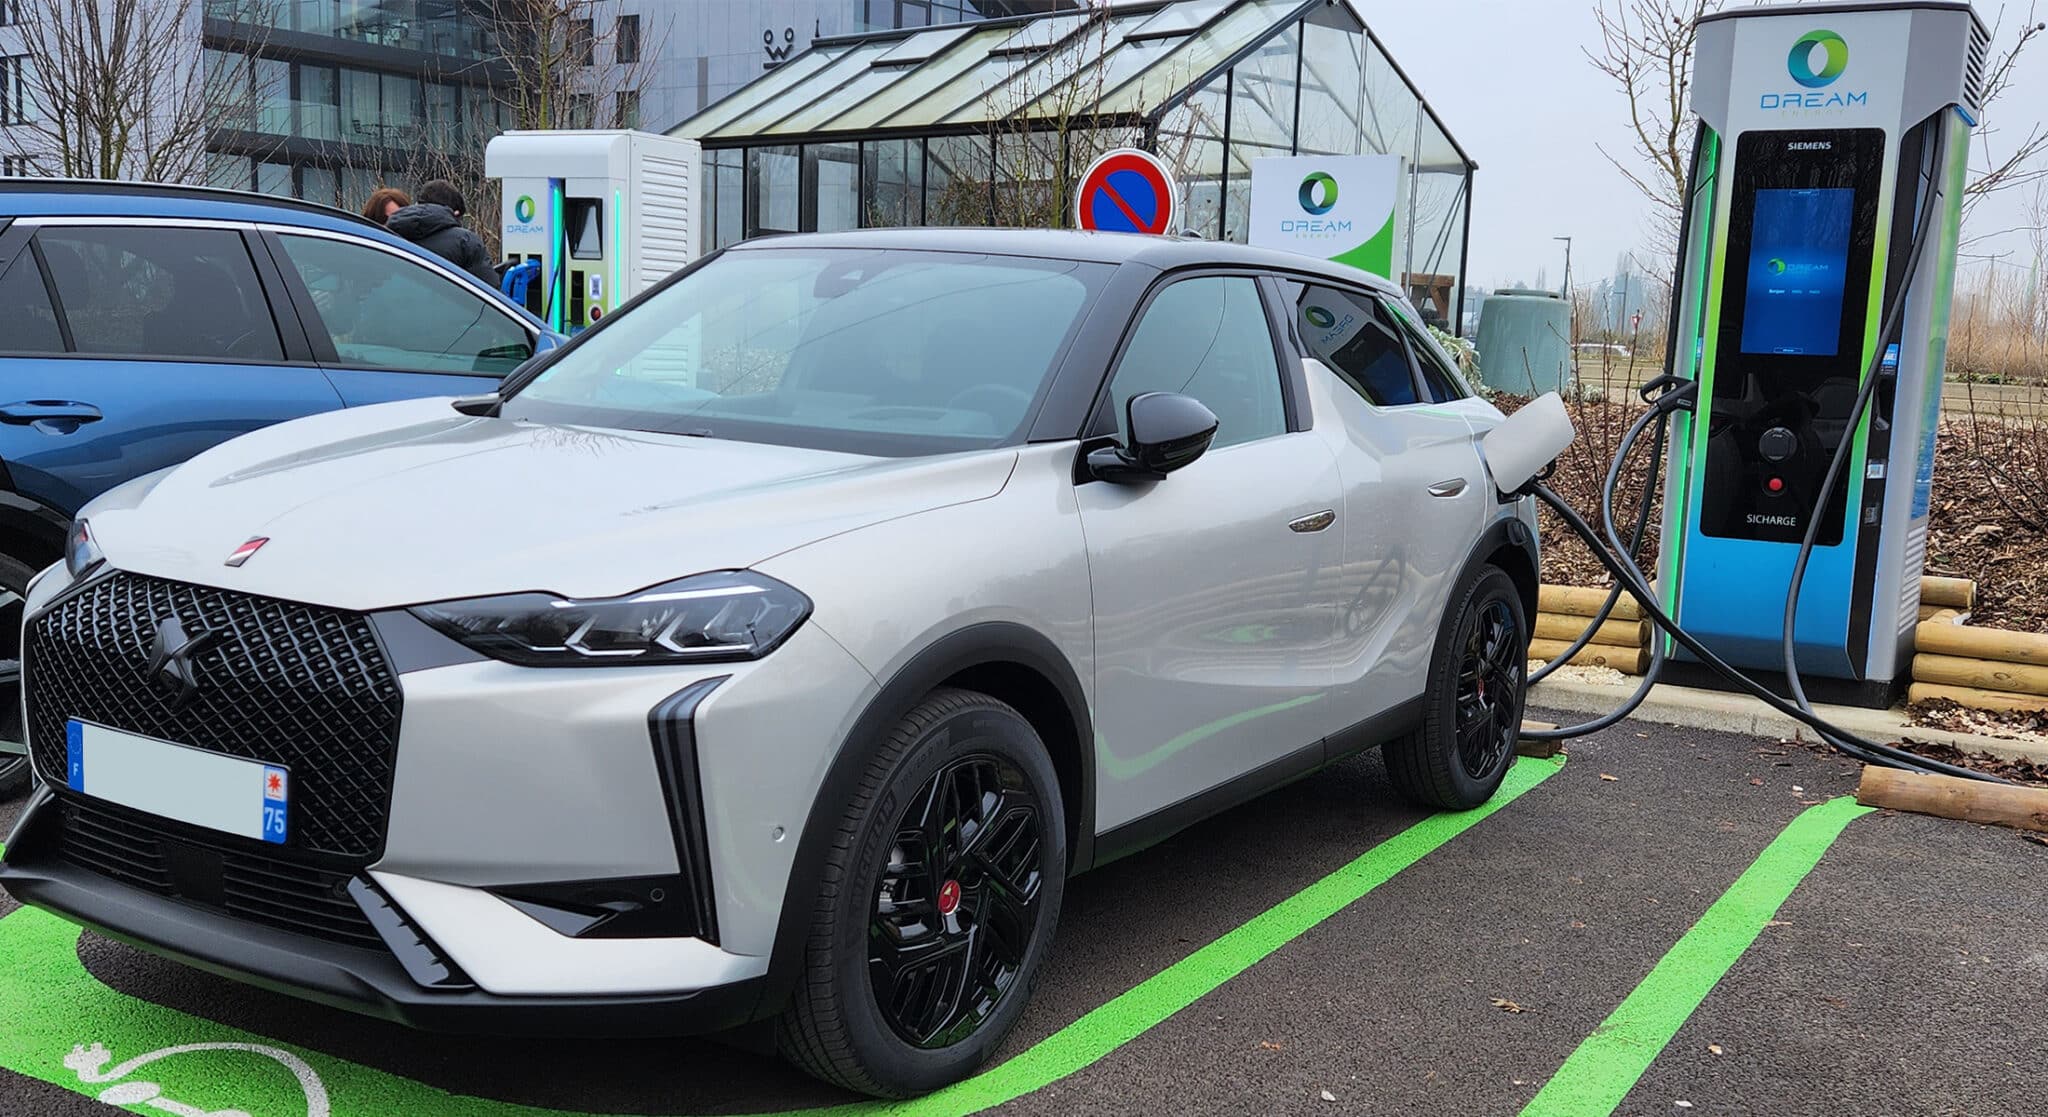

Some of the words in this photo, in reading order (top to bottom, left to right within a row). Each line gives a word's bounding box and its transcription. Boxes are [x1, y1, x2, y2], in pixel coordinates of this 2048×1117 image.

[1760, 91, 1867, 109] DREAM
[1787, 141, 1832, 151] SIEMENS
[506, 225, 543, 233] DREAM
[1281, 220, 1352, 232] DREAM
[1746, 514, 1797, 527] SICHARGE
[73, 762, 80, 777] F
[264, 806, 285, 834] 75
